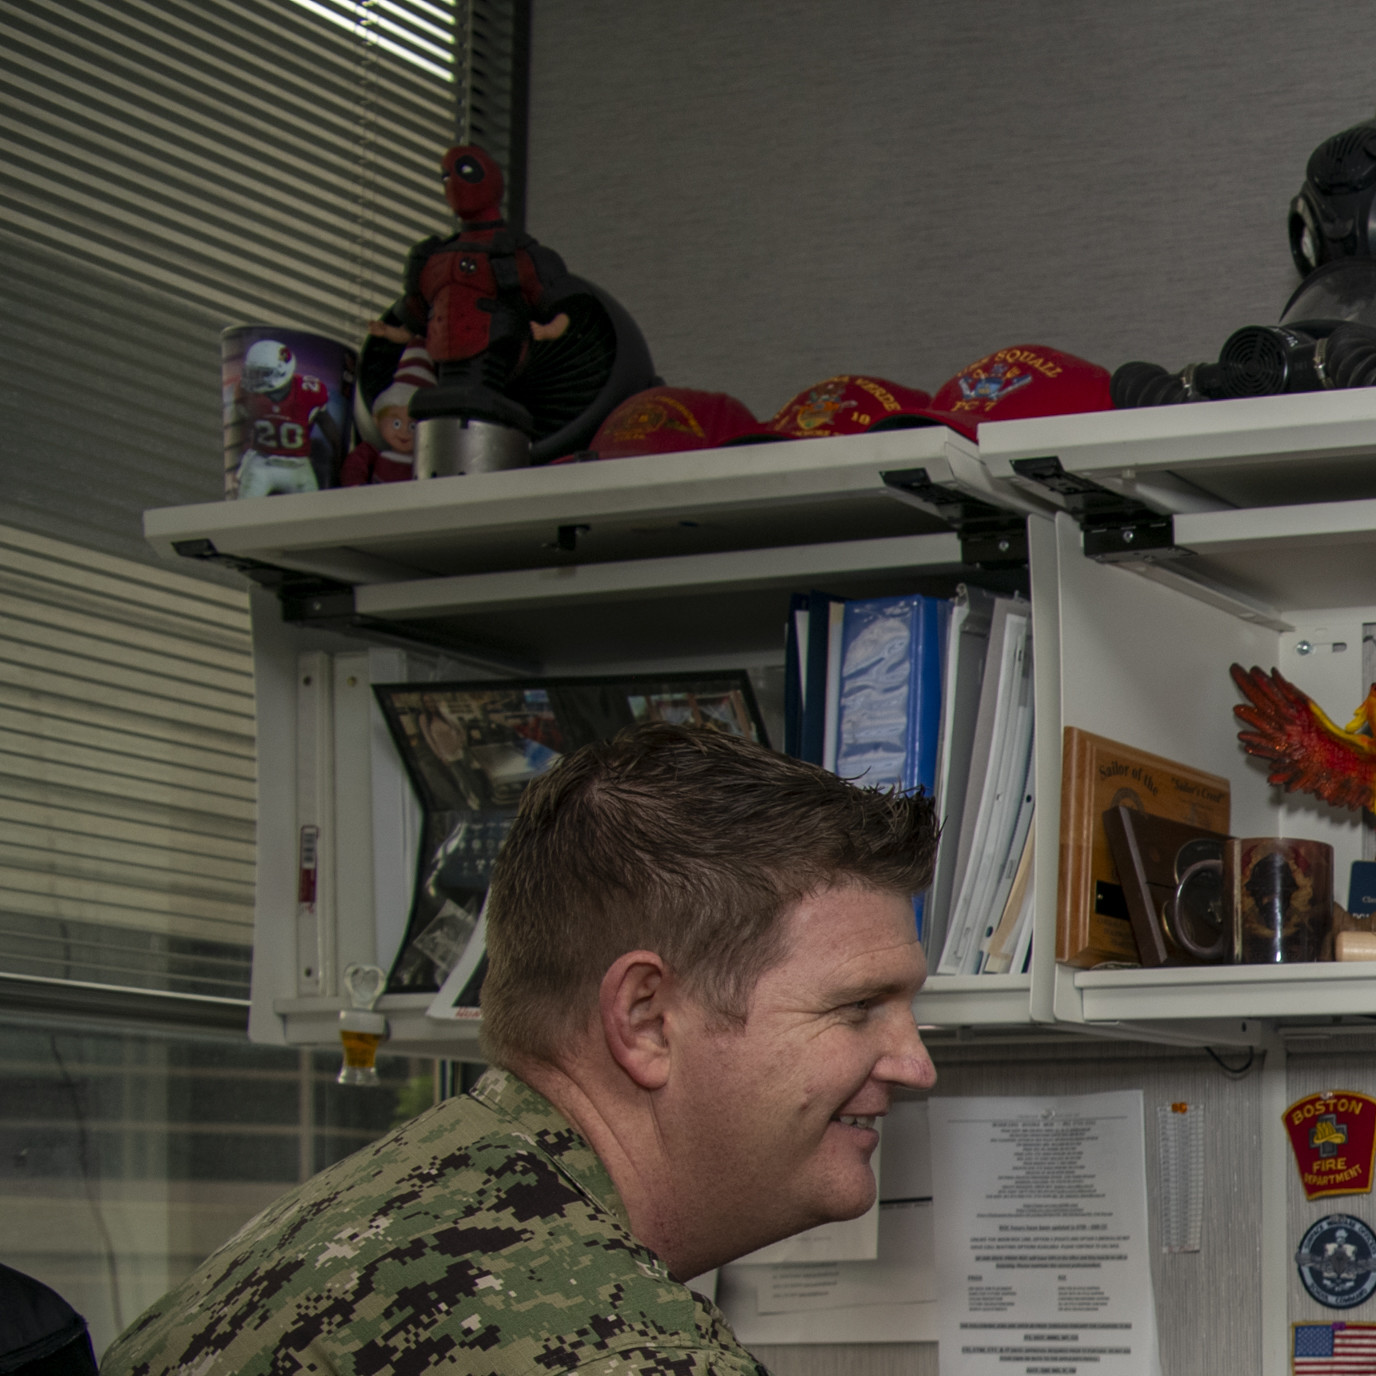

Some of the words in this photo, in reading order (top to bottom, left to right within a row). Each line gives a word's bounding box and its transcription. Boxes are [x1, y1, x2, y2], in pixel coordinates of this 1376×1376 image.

[994, 349, 1063, 378] SQUALL
[855, 378, 901, 412] VERDE
[254, 420, 304, 449] 20
[1099, 762, 1129, 780] Sailor
[1132, 769, 1142, 783] of
[1144, 775, 1158, 797] the
[1291, 1098, 1363, 1126] BOSTON
[1304, 1164, 1362, 1186] DEPARTMENT
[1312, 1157, 1347, 1174] FIRE
